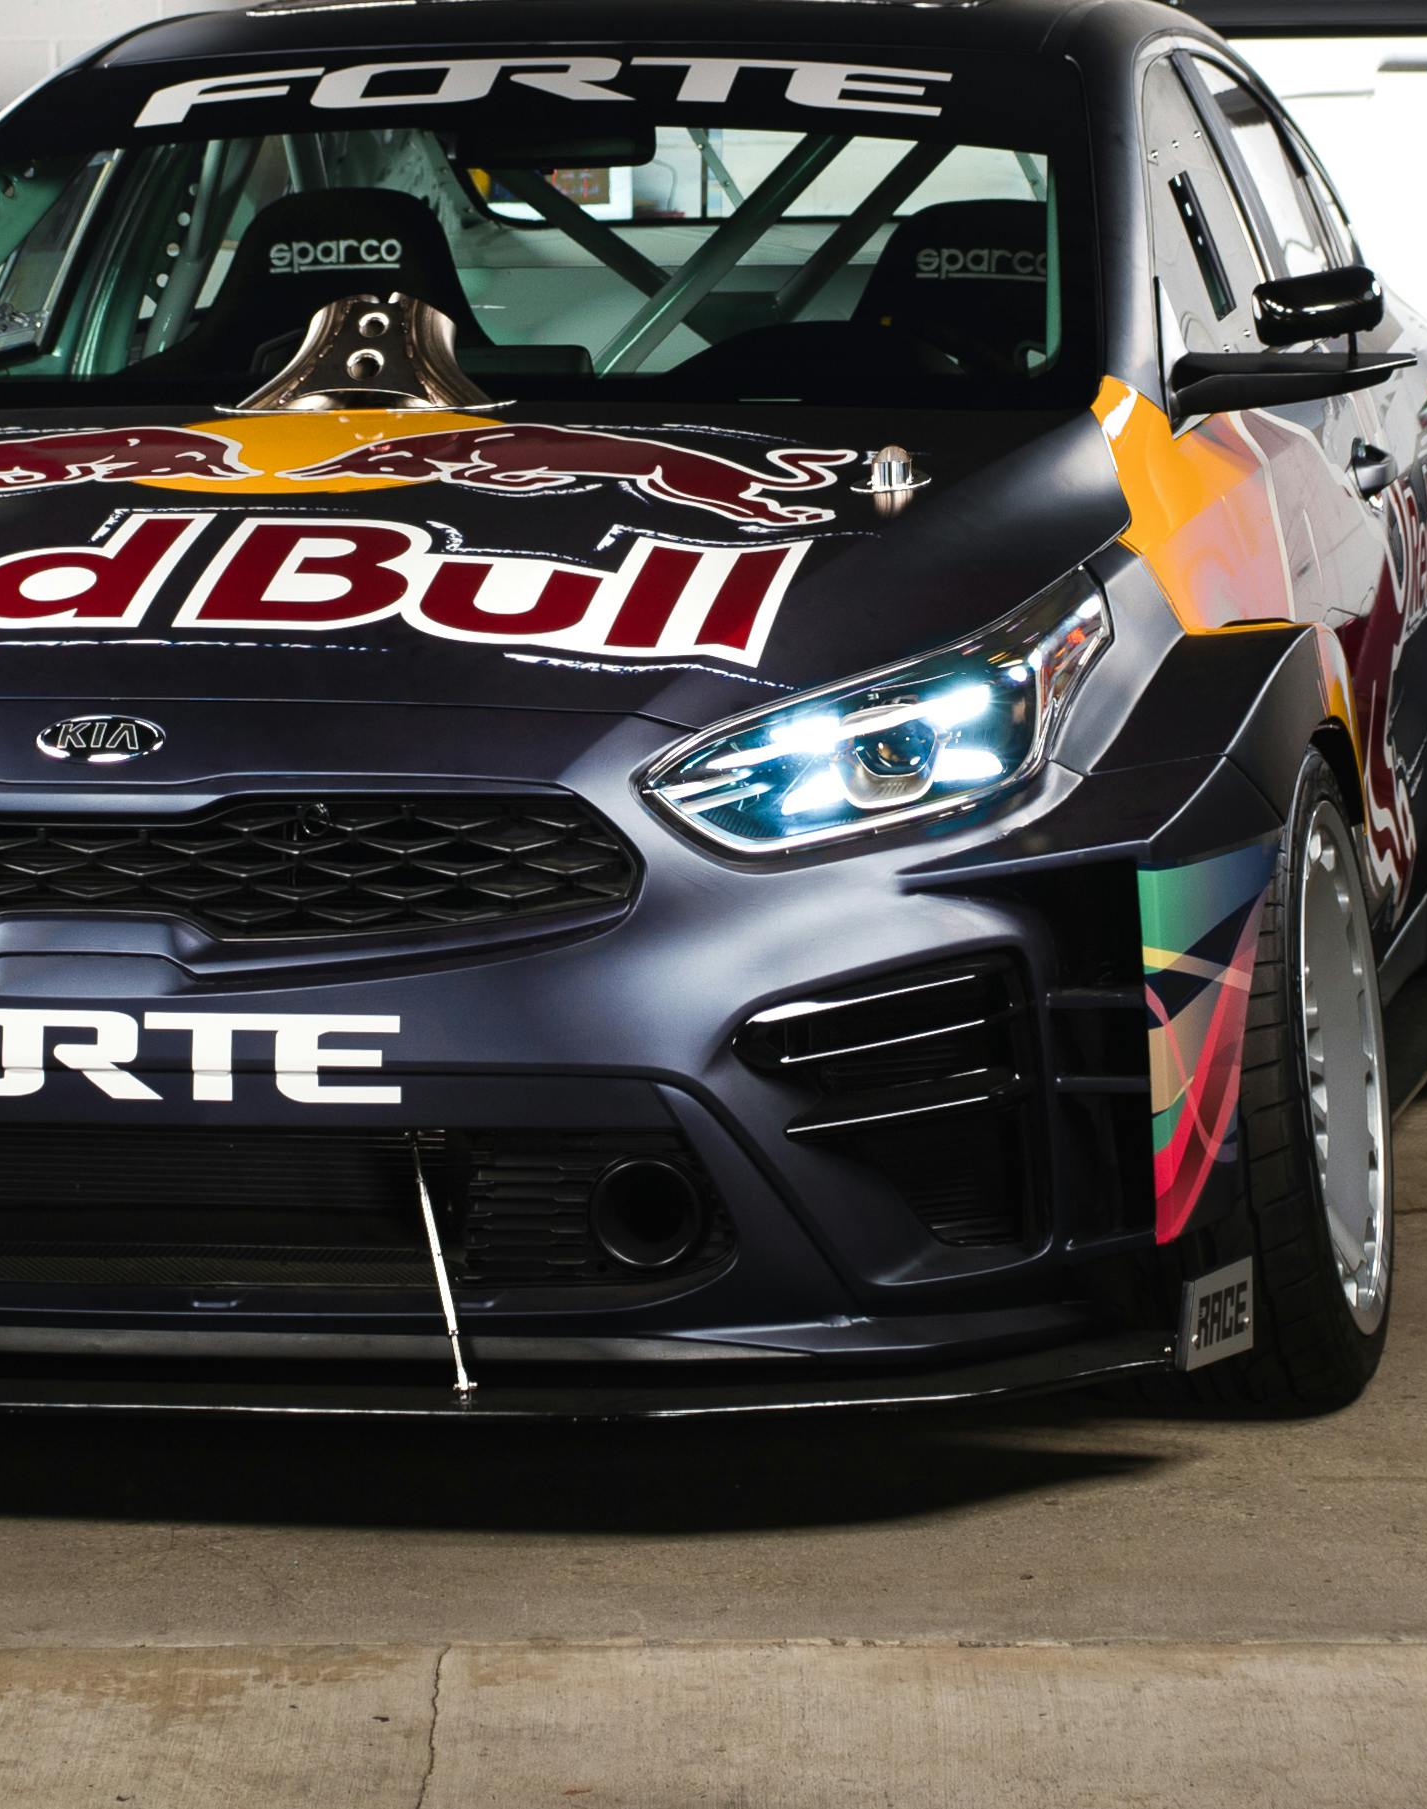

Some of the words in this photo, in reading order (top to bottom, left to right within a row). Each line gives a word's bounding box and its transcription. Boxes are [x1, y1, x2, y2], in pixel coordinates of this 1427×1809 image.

[134, 56, 954, 128] FORTE
[269, 238, 402, 273] sparco
[193, 523, 791, 651] Bull
[57, 722, 140, 750] KIA
[1195, 1280, 1248, 1351] RACE
